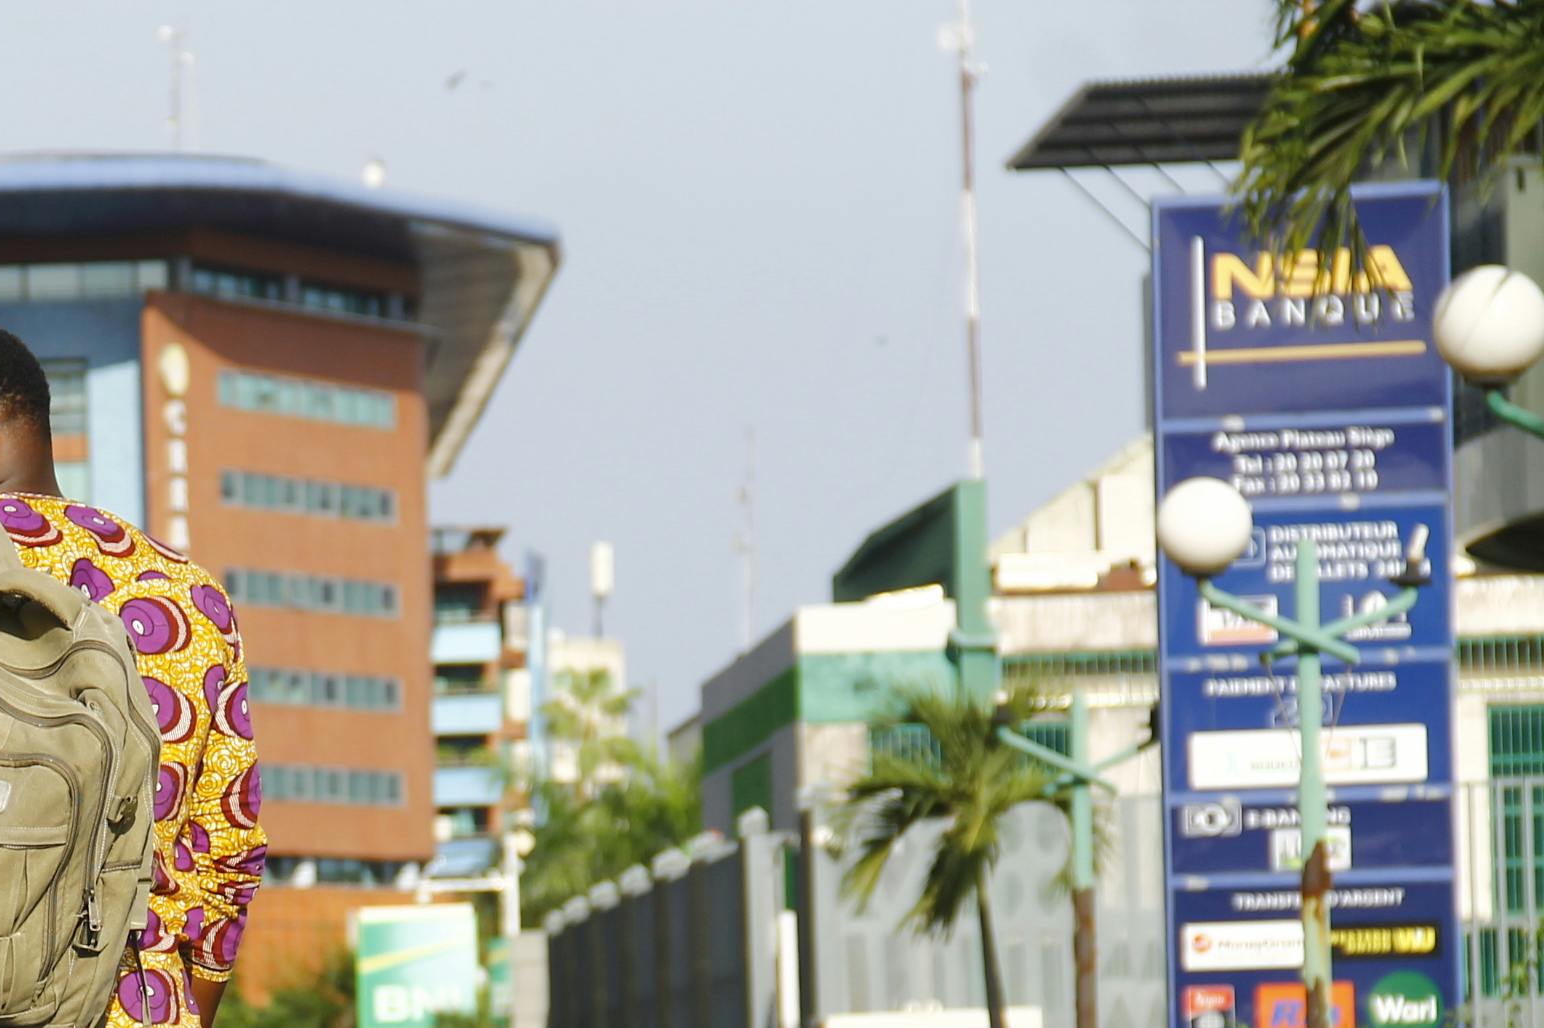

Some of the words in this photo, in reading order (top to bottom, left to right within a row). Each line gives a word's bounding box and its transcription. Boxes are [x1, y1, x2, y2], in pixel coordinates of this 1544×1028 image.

[1213, 291, 1415, 331] BANQUE
[1280, 429, 1345, 448] Plateau
[1270, 522, 1398, 543] DISTRIBUTEUR
[1322, 671, 1396, 691] ACTURES
[1373, 996, 1437, 1023] Wari
